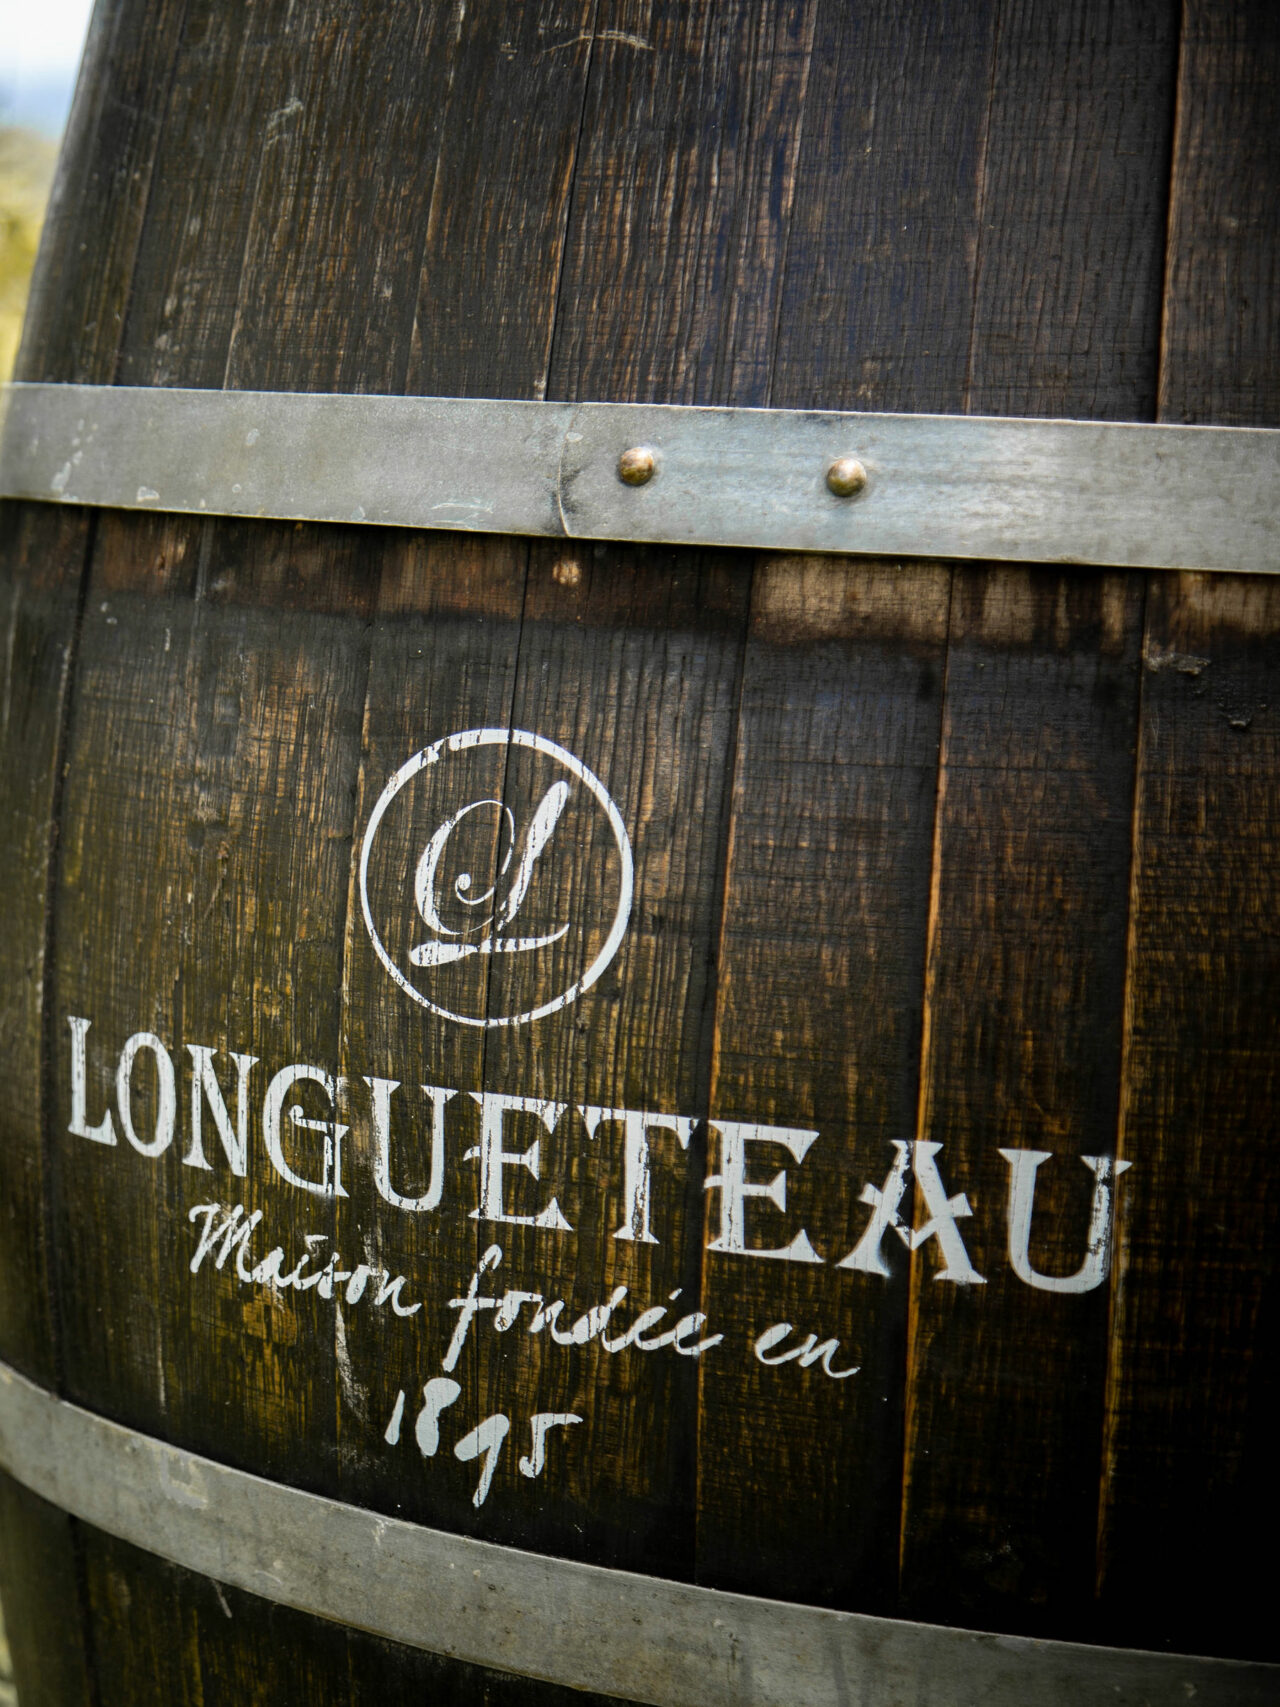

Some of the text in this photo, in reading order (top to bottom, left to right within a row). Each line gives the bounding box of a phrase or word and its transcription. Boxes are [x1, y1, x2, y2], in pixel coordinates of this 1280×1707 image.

[67, 1015, 1133, 1295] LONGUETEAU
[188, 1203, 861, 1379] Maison fondée en
[384, 1376, 584, 1508] 1895
